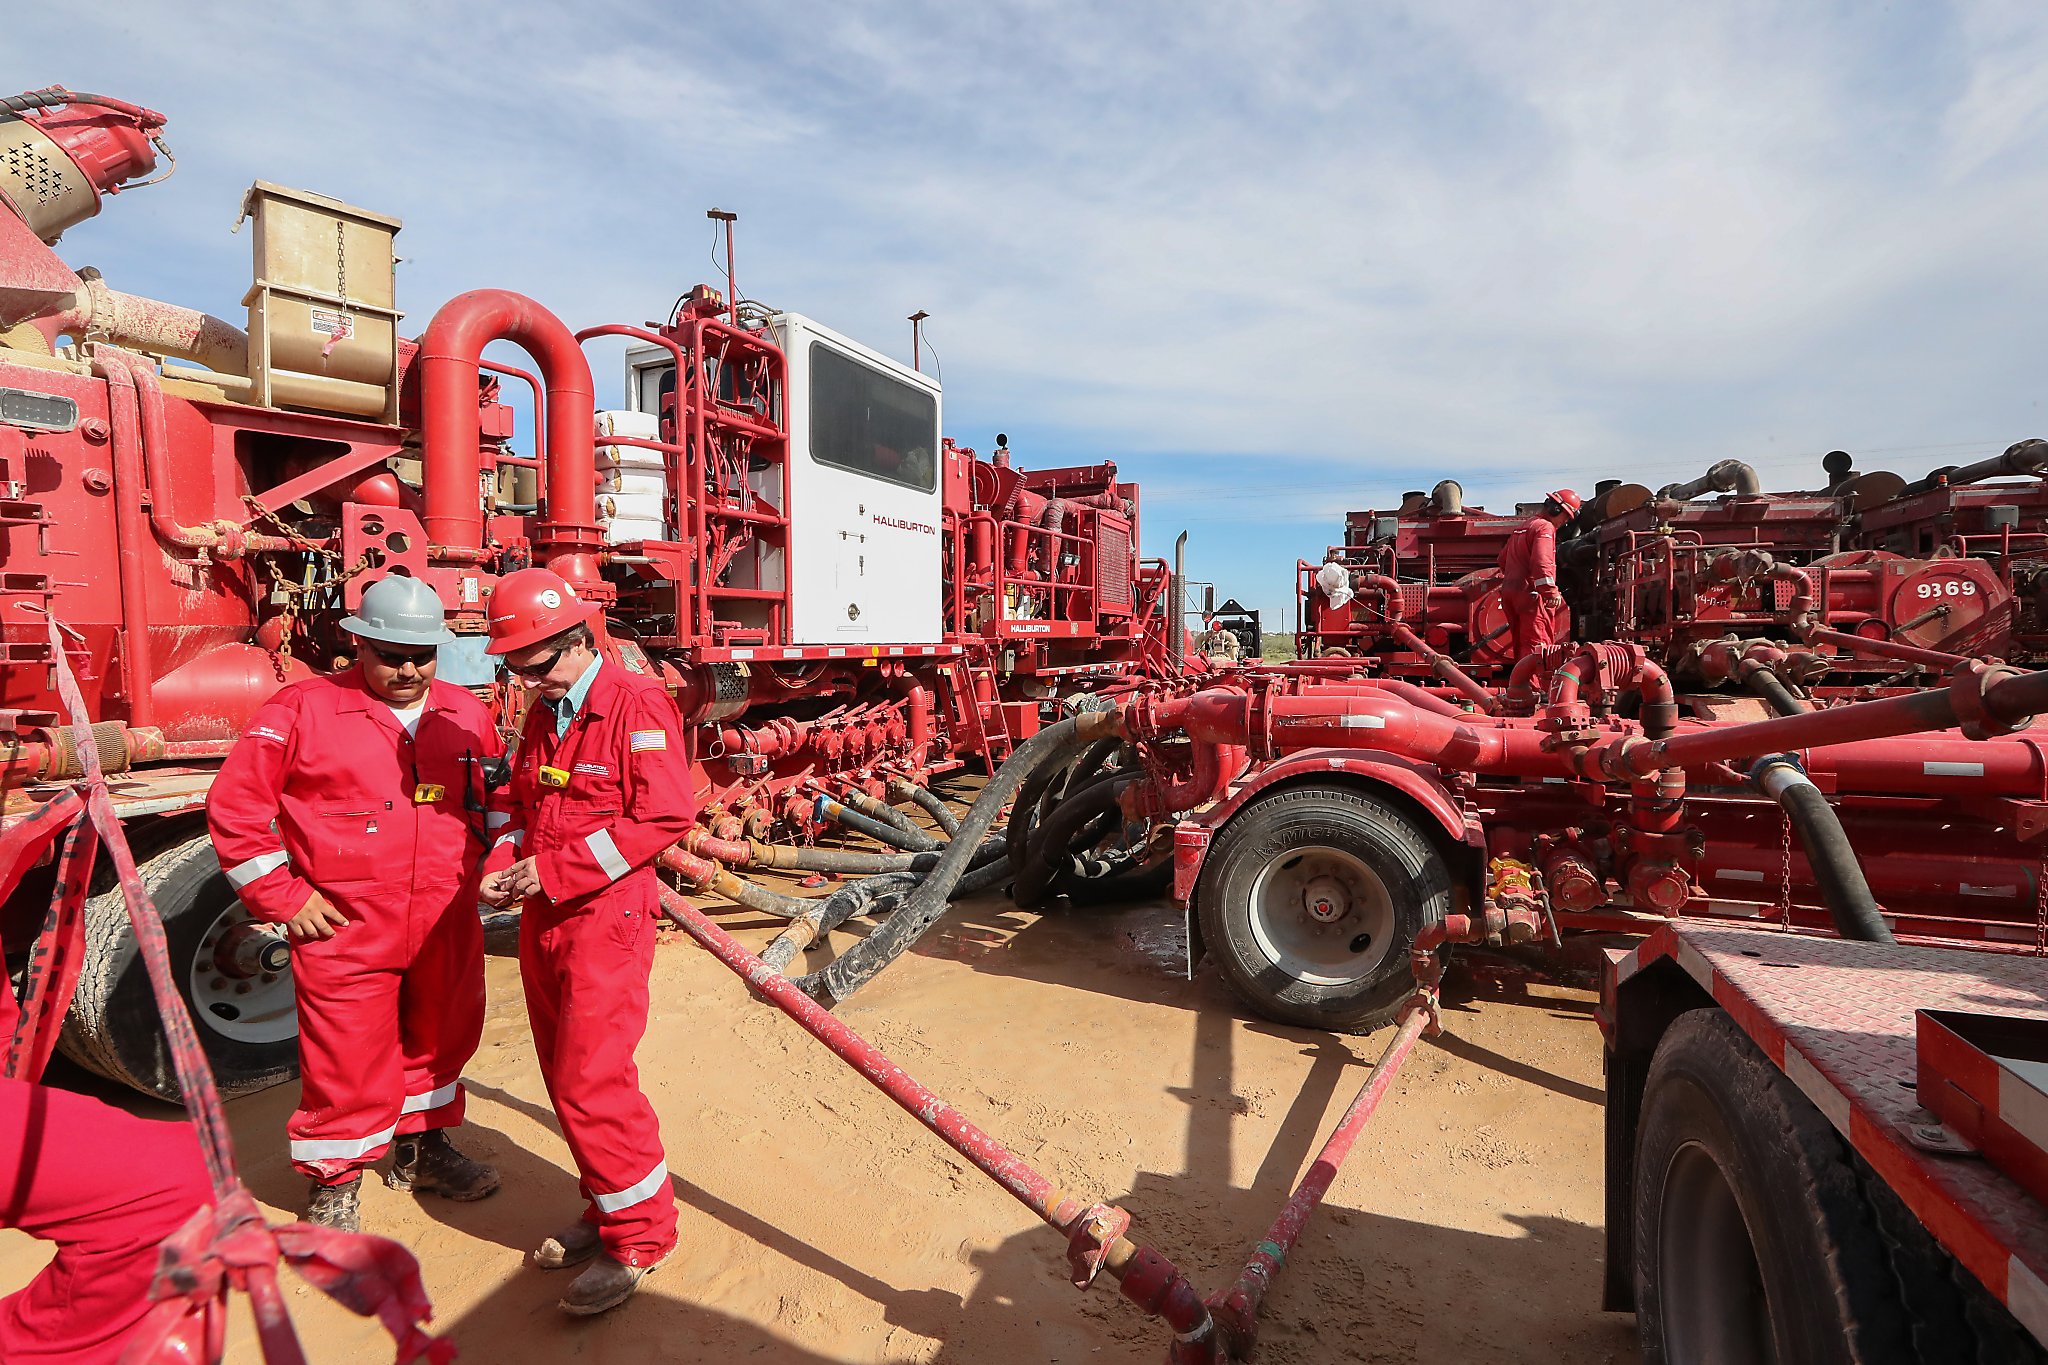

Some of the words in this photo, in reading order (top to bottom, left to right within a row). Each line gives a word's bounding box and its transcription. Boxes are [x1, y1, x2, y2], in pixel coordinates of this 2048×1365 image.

[873, 514, 936, 535] HALLIBURTON
[1917, 581, 1976, 599] 9369
[1010, 625, 1051, 633] HALLIBURTON
